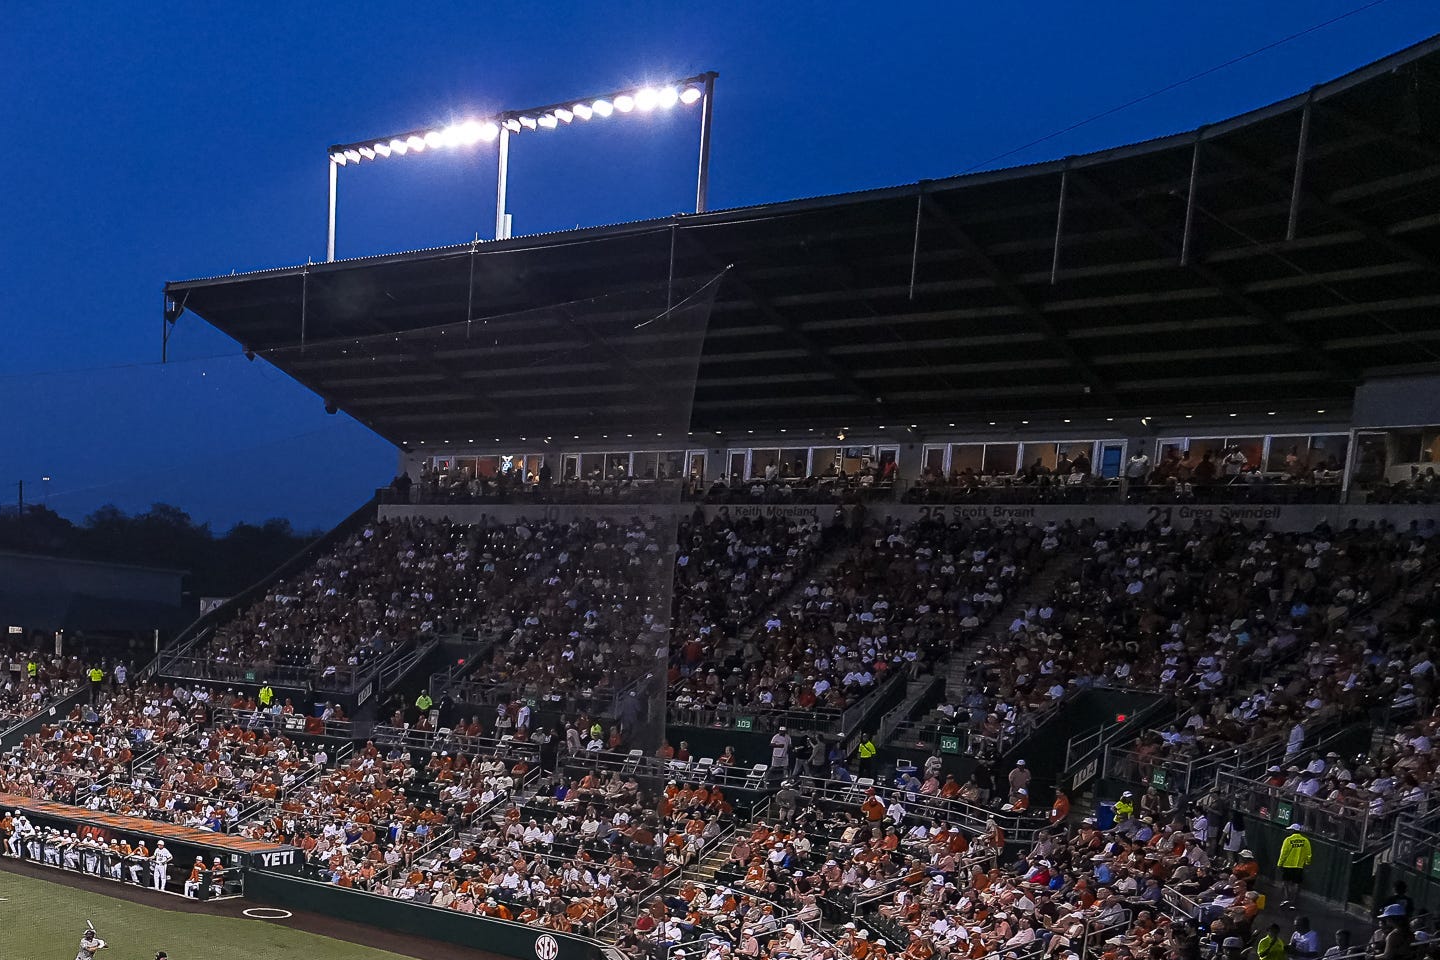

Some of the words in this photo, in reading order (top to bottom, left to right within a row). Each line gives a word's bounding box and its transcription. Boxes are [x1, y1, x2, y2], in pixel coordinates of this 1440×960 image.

[735, 506, 760, 517] Keith
[766, 506, 817, 517] Moreland
[952, 506, 987, 518] Scott
[993, 506, 1035, 519] Bryant
[1178, 506, 1212, 520] Greg
[1220, 506, 1281, 519] Swindell
[737, 720, 751, 729] 103
[942, 740, 957, 750] 104
[1153, 774, 1164, 785] 105
[1278, 808, 1290, 820] 106
[262, 851, 295, 867] YETI
[537, 935, 556, 960] SEC
